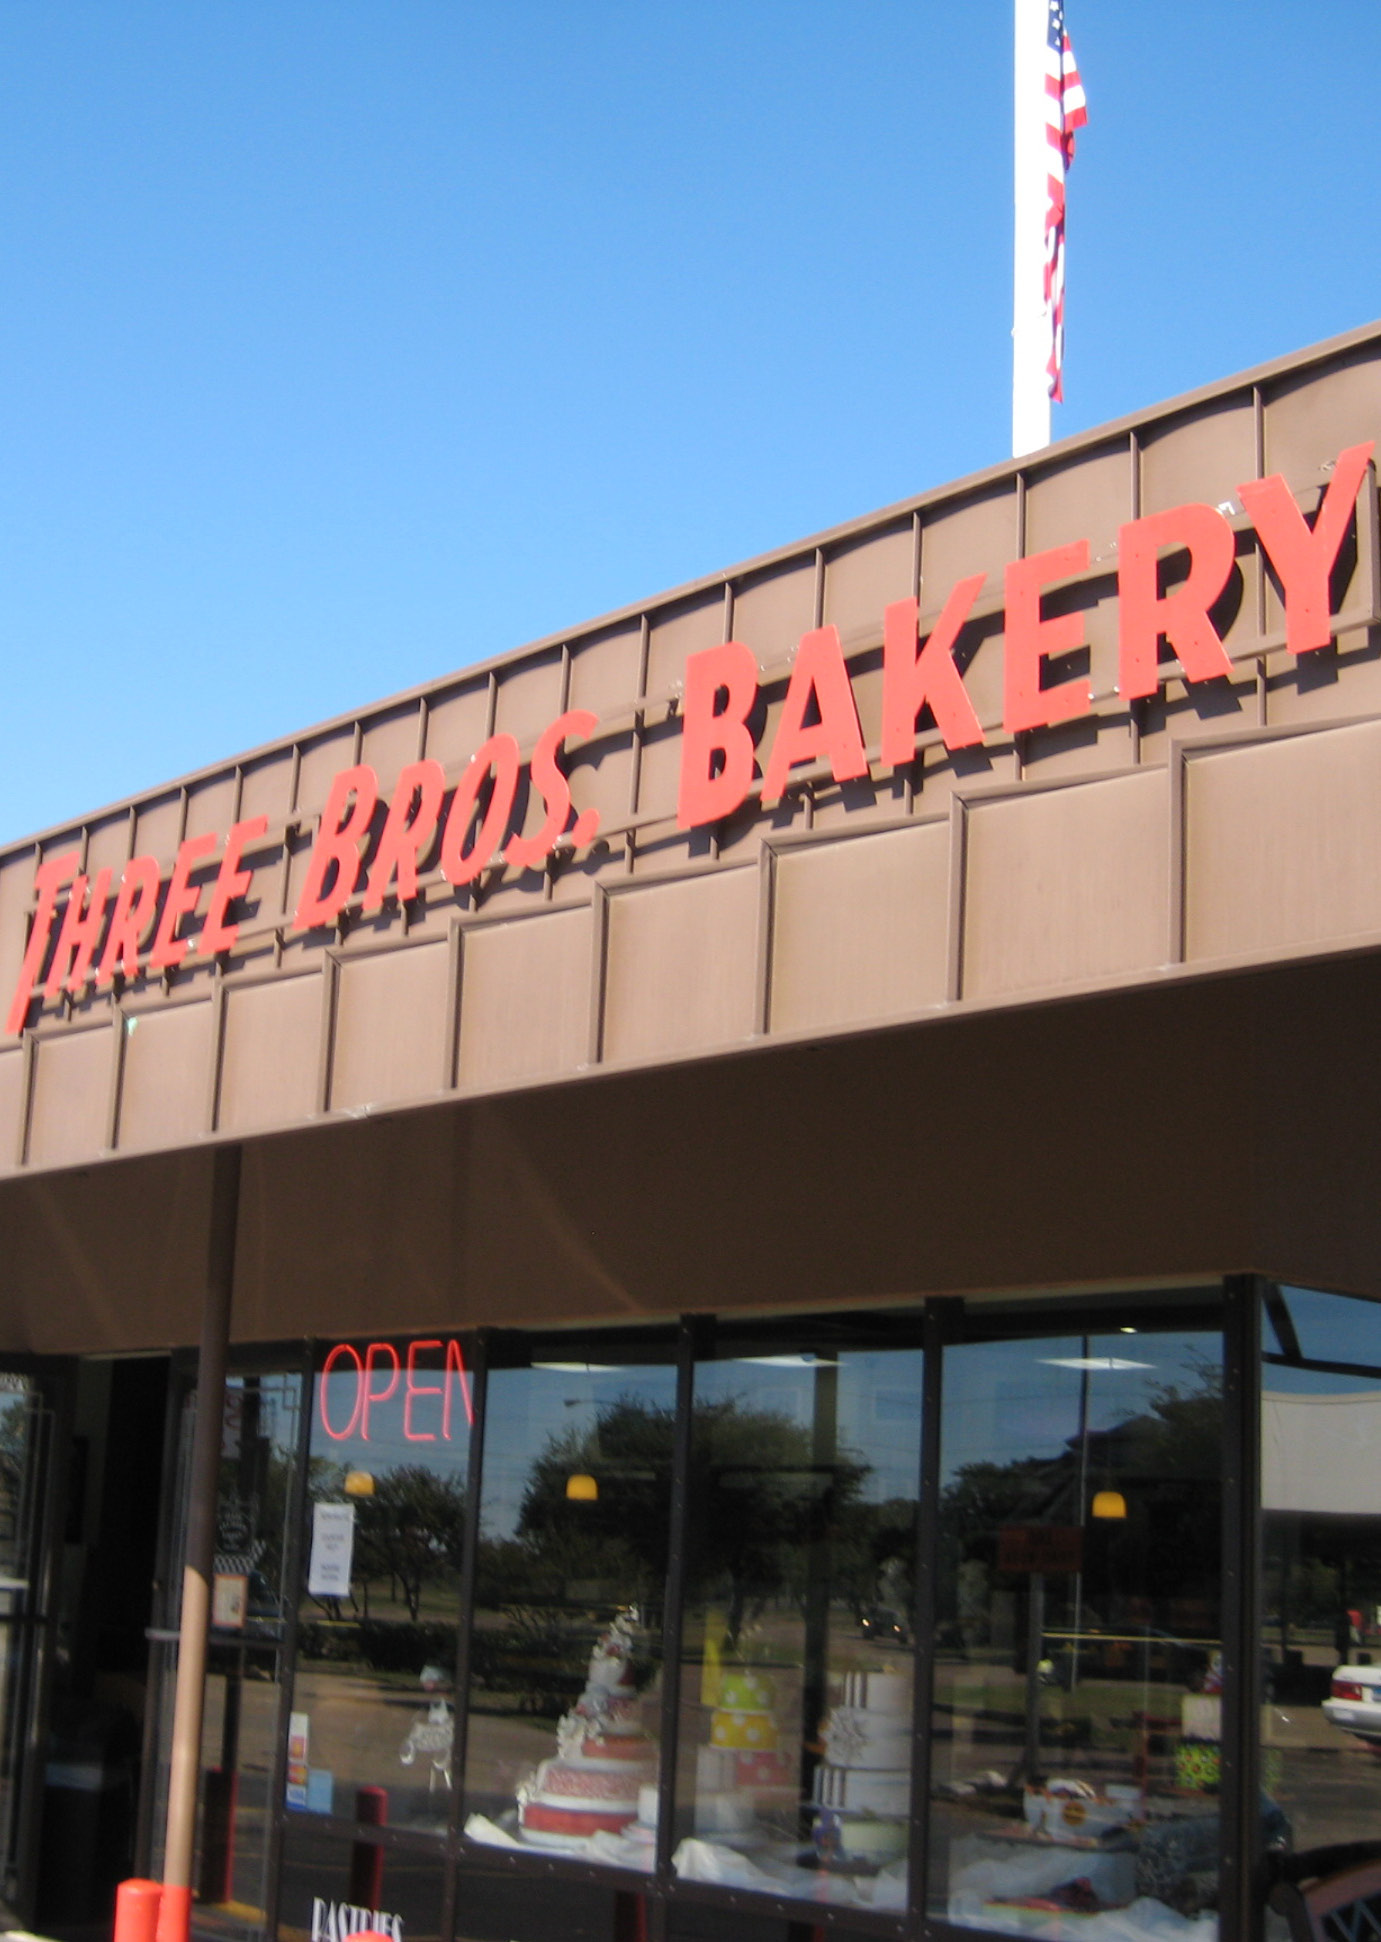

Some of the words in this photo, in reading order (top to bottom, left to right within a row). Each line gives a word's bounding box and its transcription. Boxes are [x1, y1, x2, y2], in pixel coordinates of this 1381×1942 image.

[4, 813, 270, 1035] THREE
[290, 709, 601, 932] BROS.
[676, 439, 1376, 830] BAKERY
[319, 1338, 475, 1442] OPEN
